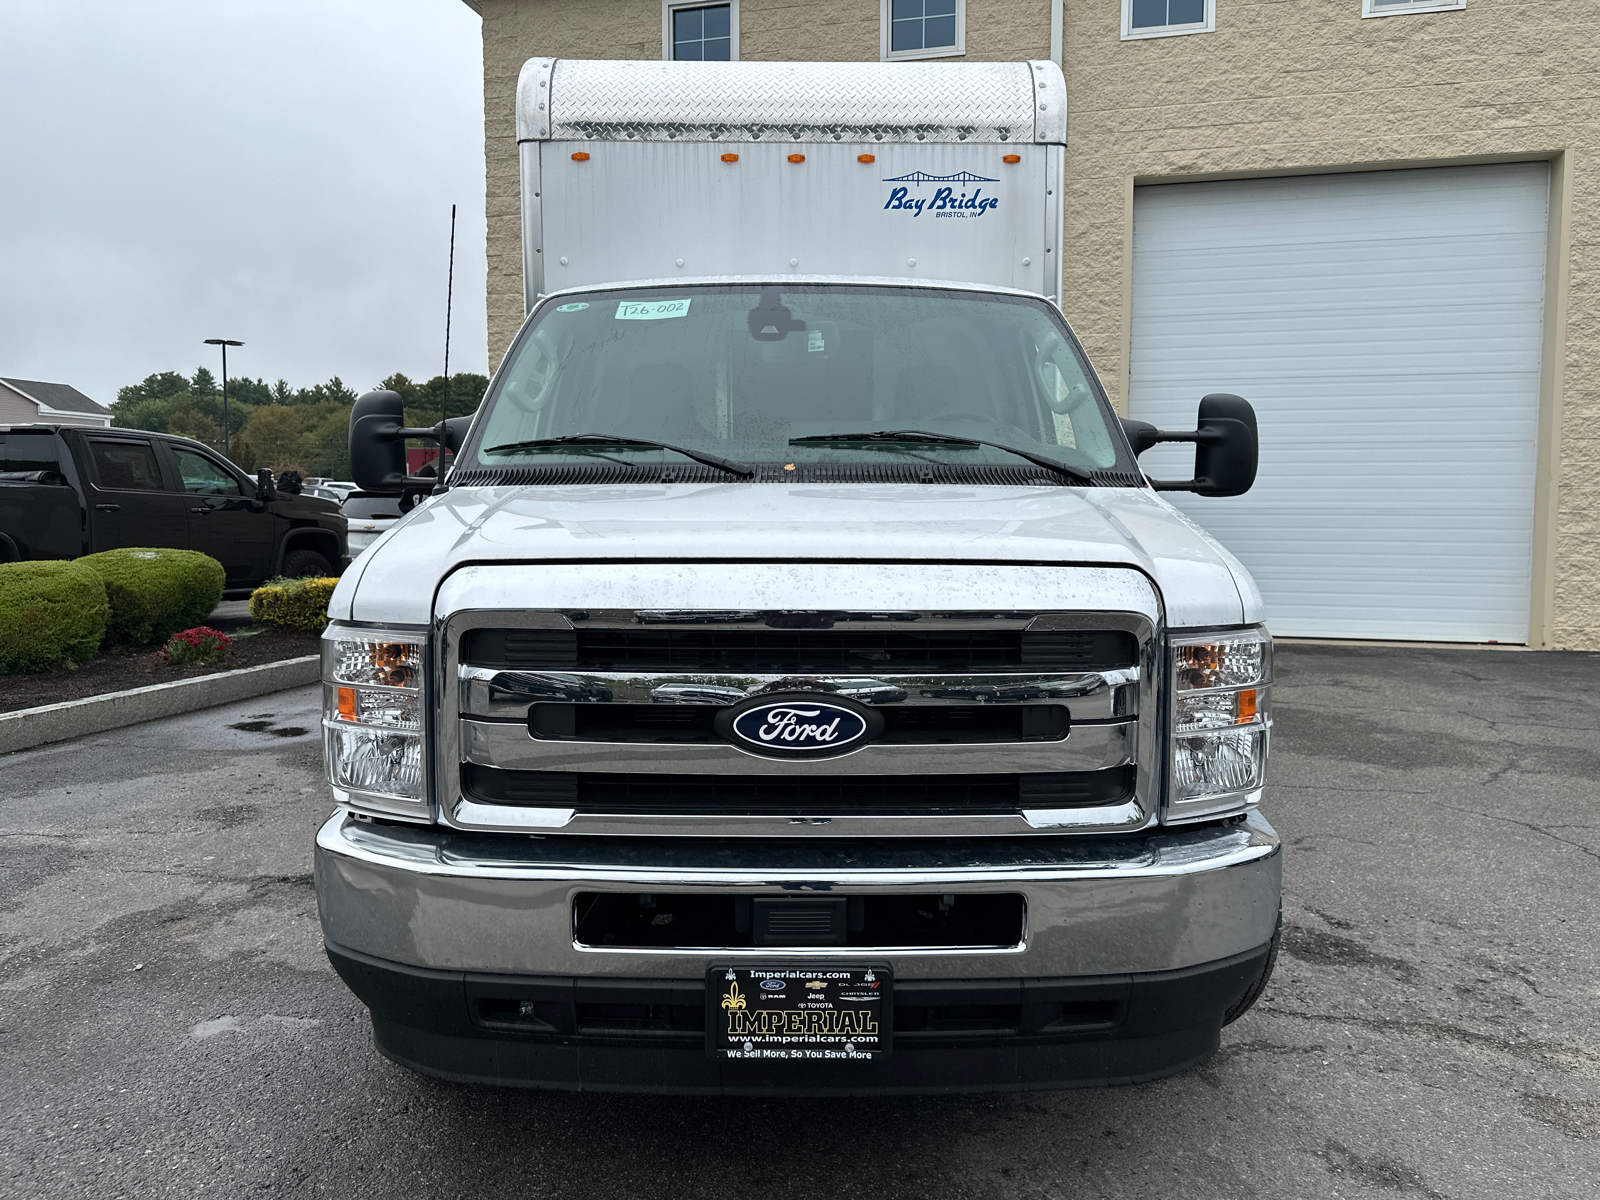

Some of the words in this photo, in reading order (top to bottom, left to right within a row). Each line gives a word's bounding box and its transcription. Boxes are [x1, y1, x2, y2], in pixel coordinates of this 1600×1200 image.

[884, 186, 926, 218] Bay
[927, 186, 998, 217] Bridge
[620, 302, 684, 316] T26-002
[758, 708, 840, 741] Ford
[750, 970, 851, 980] Imperialcars.com
[728, 1010, 878, 1034] IMPERIAL
[728, 1035, 878, 1044] www.imperialcars.com
[727, 1050, 741, 1058] We
[744, 1050, 760, 1058] Sell
[763, 1050, 788, 1059] More,
[791, 1050, 802, 1058] So
[805, 1050, 822, 1058] You
[824, 1050, 847, 1058] Save
[849, 1050, 872, 1059] More
